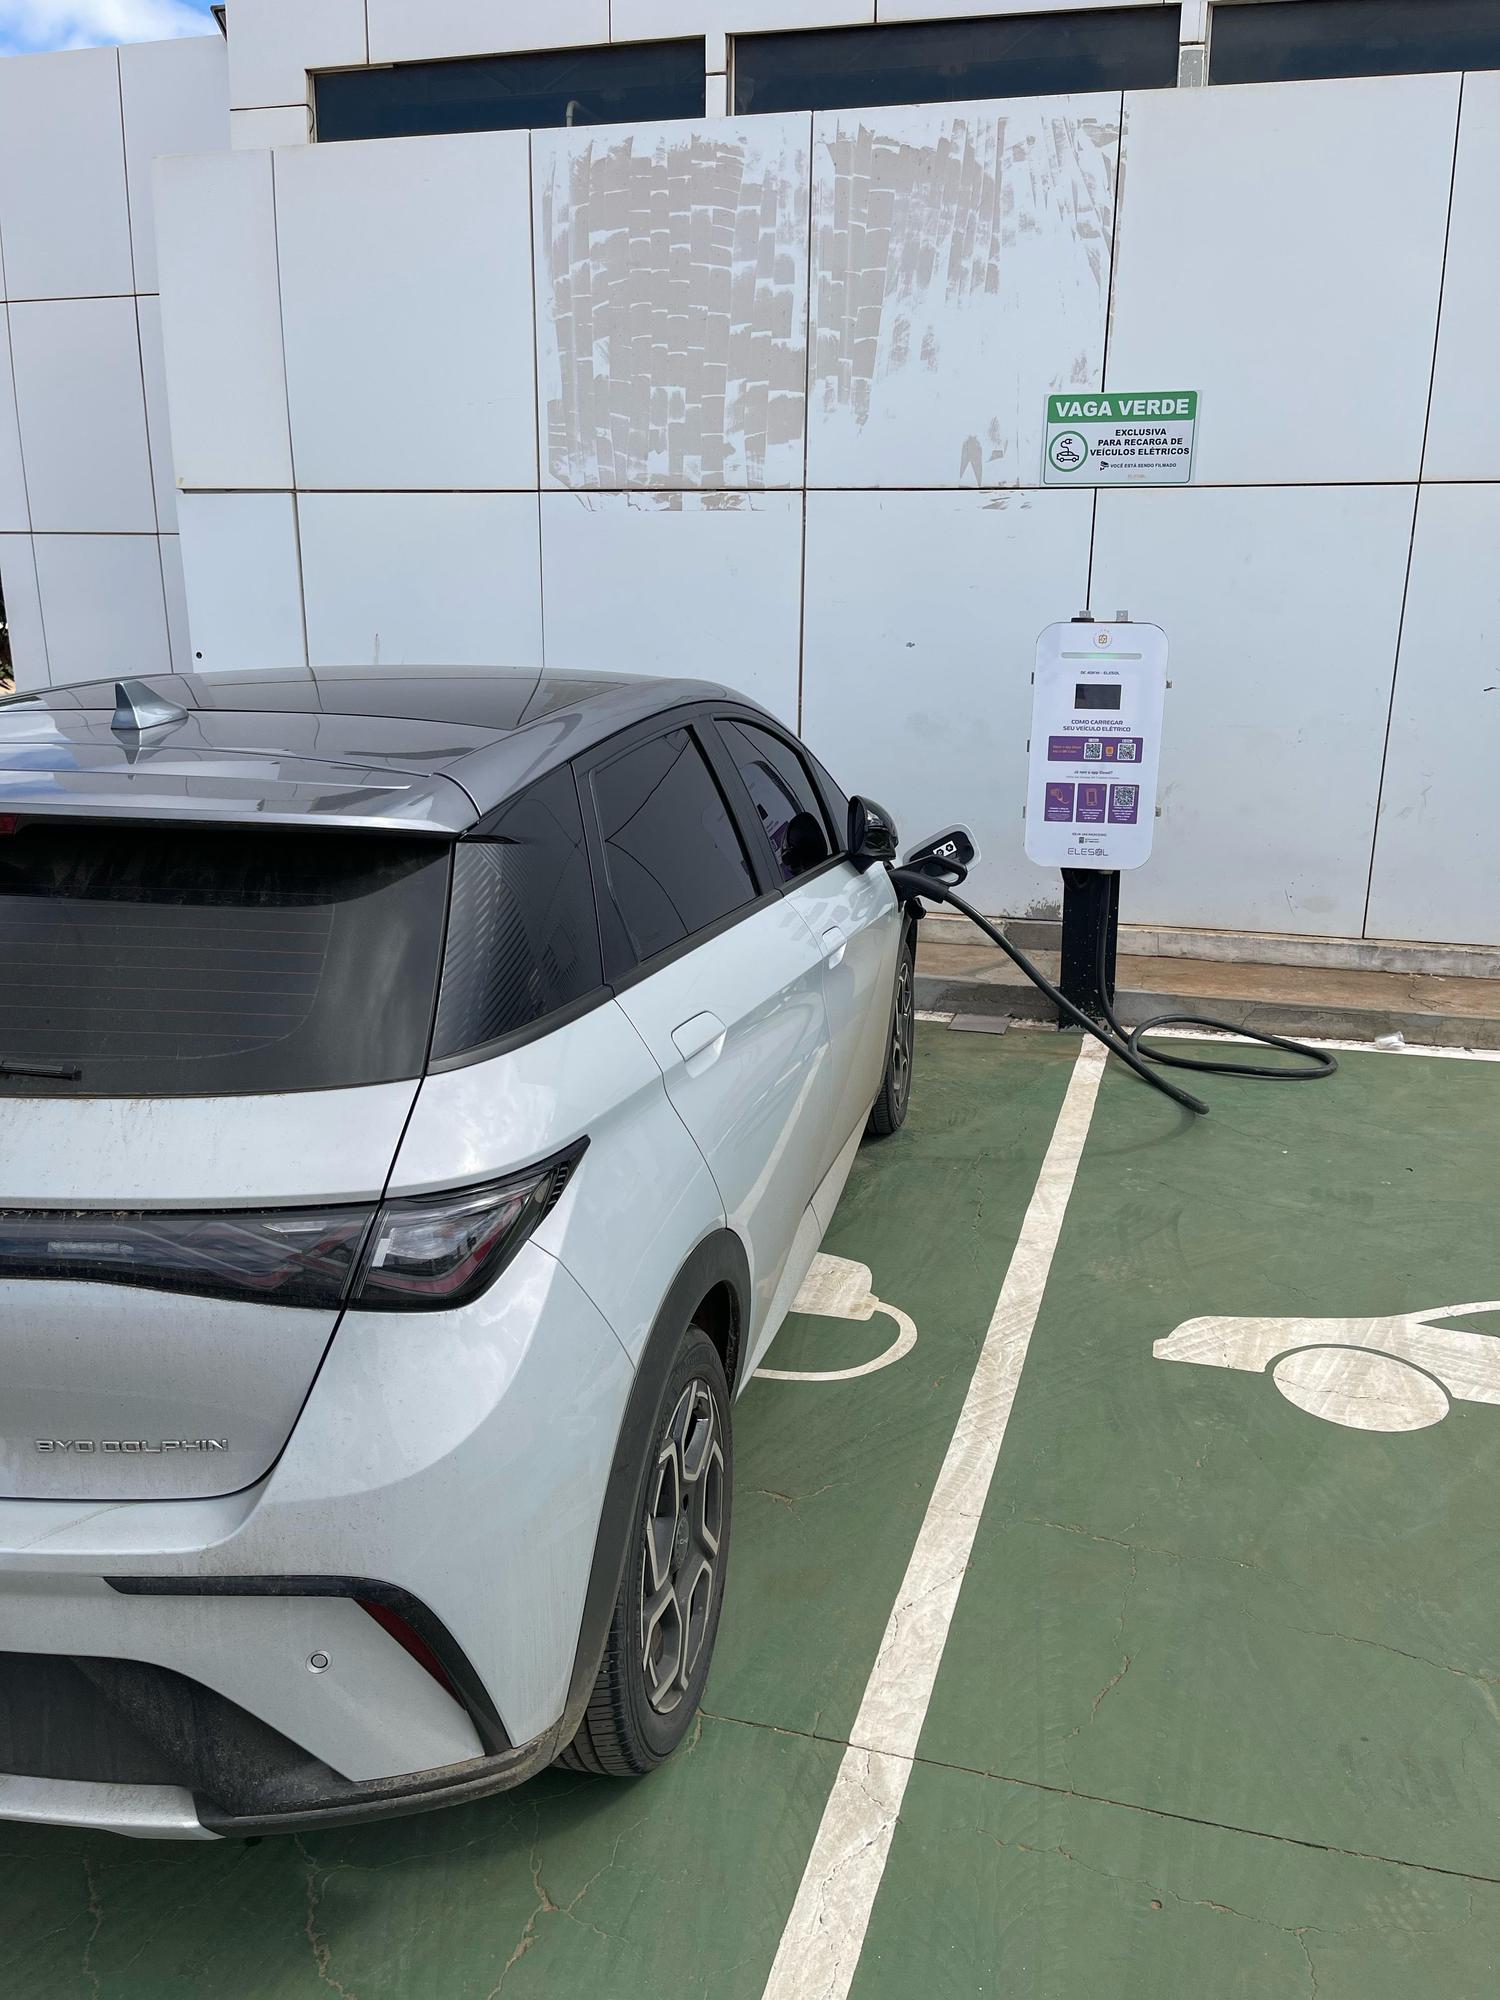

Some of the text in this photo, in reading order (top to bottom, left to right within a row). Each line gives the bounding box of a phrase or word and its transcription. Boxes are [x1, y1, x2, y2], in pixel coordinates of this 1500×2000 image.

[1055, 398, 1190, 417] VAGA VERDE
[1115, 428, 1167, 437] EXCLUSIVA
[1097, 437, 1183, 447] PARA RECARGA DE
[1090, 446, 1190, 456] VEÍCULOS ELÉTRICOS
[36, 1438, 229, 1454] BYD DOLPHIN
